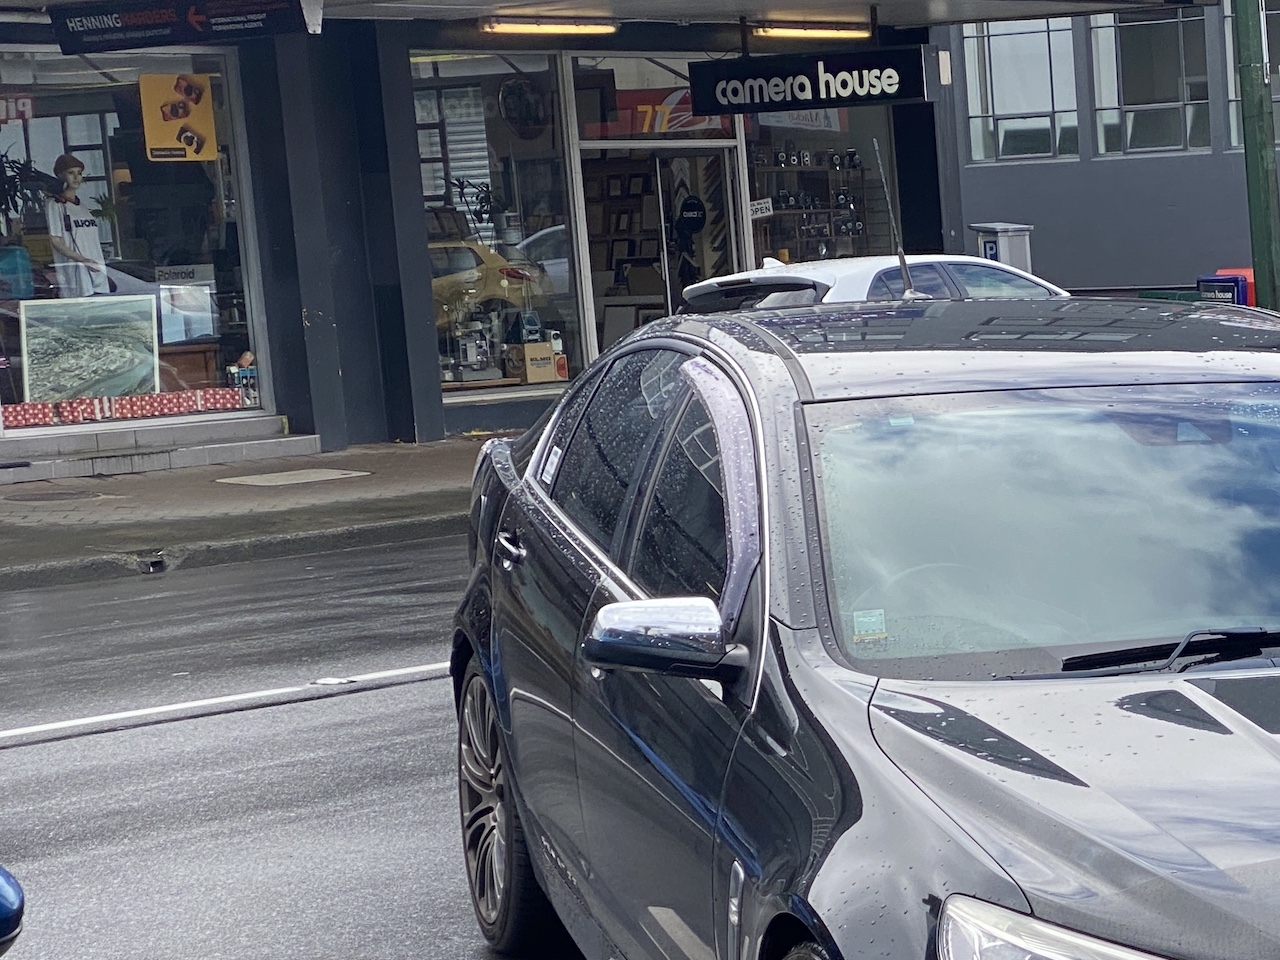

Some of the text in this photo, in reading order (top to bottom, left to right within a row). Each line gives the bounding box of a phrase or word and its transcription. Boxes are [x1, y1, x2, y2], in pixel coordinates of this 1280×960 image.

[66, 14, 122, 32] HENNING
[715, 61, 900, 105] camera house
[637, 104, 670, 133] 77
[157, 268, 195, 280] Polaroid
[1215, 289, 1233, 299] house
